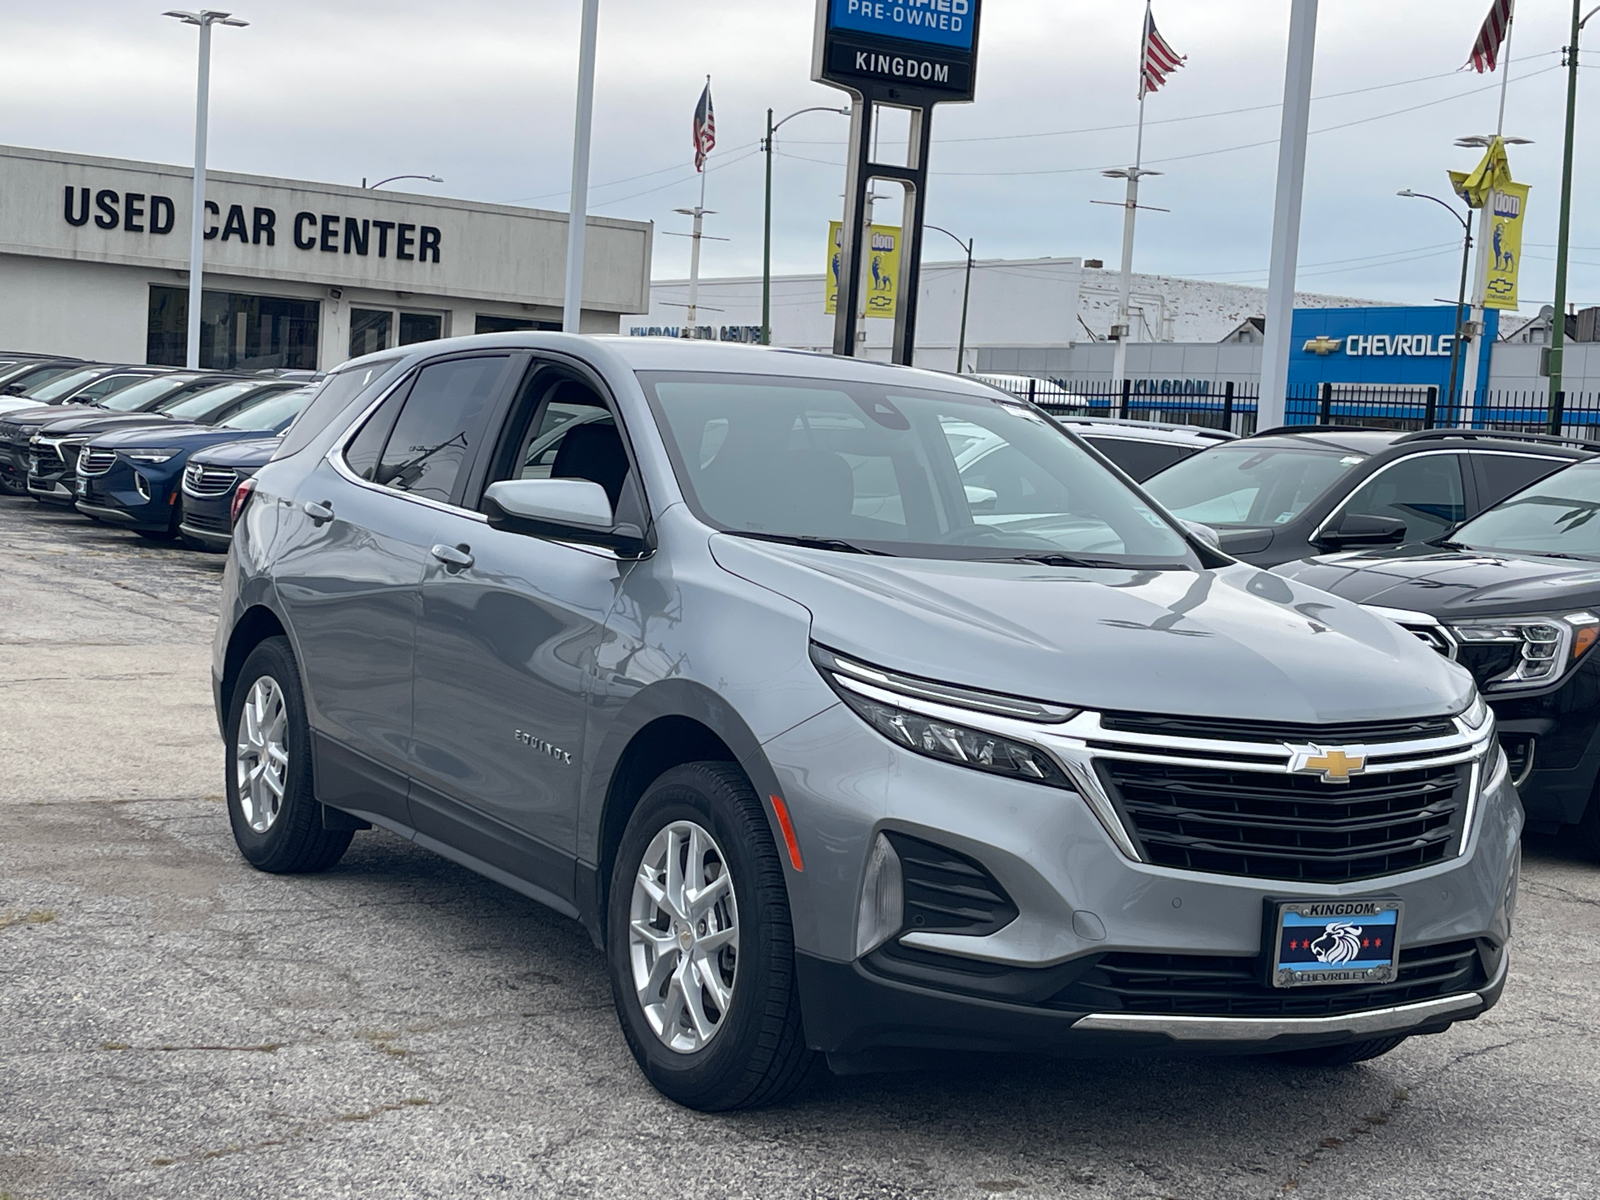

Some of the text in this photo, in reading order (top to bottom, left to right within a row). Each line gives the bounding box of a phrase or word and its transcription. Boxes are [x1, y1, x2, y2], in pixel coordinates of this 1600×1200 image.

[848, 0, 963, 32] PRE-OWNED
[855, 51, 949, 83] KINGDOM
[1495, 190, 1520, 214] dom
[64, 186, 442, 264] USED CAR CENTER
[872, 232, 894, 249] dom
[720, 325, 772, 345] CENTE
[514, 729, 572, 765] EQUINOX
[1310, 903, 1375, 916] KINGDOM
[1301, 971, 1367, 982] CHEVROLET
